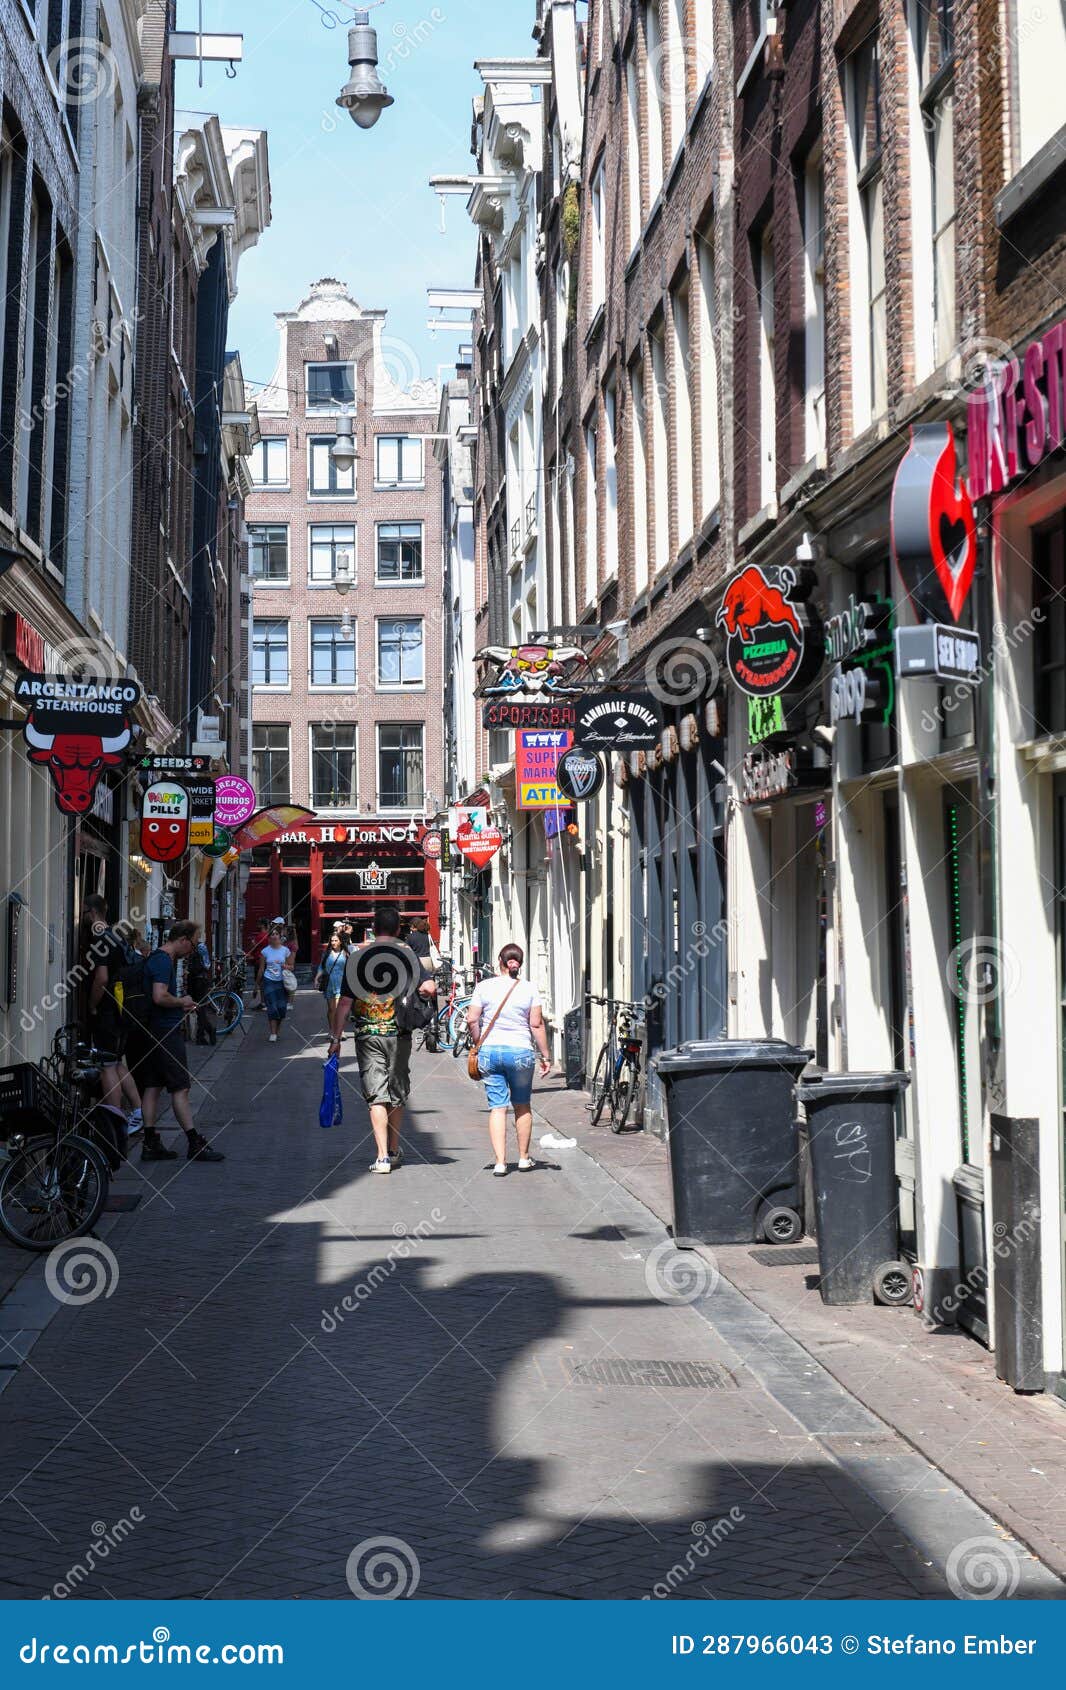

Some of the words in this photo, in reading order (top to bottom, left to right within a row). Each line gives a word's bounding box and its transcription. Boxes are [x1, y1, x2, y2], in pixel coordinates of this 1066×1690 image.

[743, 639, 788, 660] PIZZERIA
[18, 681, 136, 701] ARGENTANGO
[36, 699, 122, 714] STEAKHOUSE
[580, 701, 626, 727] CANNIBALE
[627, 702, 658, 727] ROYALE
[153, 757, 192, 768] SEEDS
[147, 791, 185, 804] PARTY
[215, 796, 250, 805] HURROS
[526, 787, 570, 801] ATM
[150, 805, 180, 815] PILLS
[281, 831, 307, 843] BAR
[361, 831, 377, 842] OR
